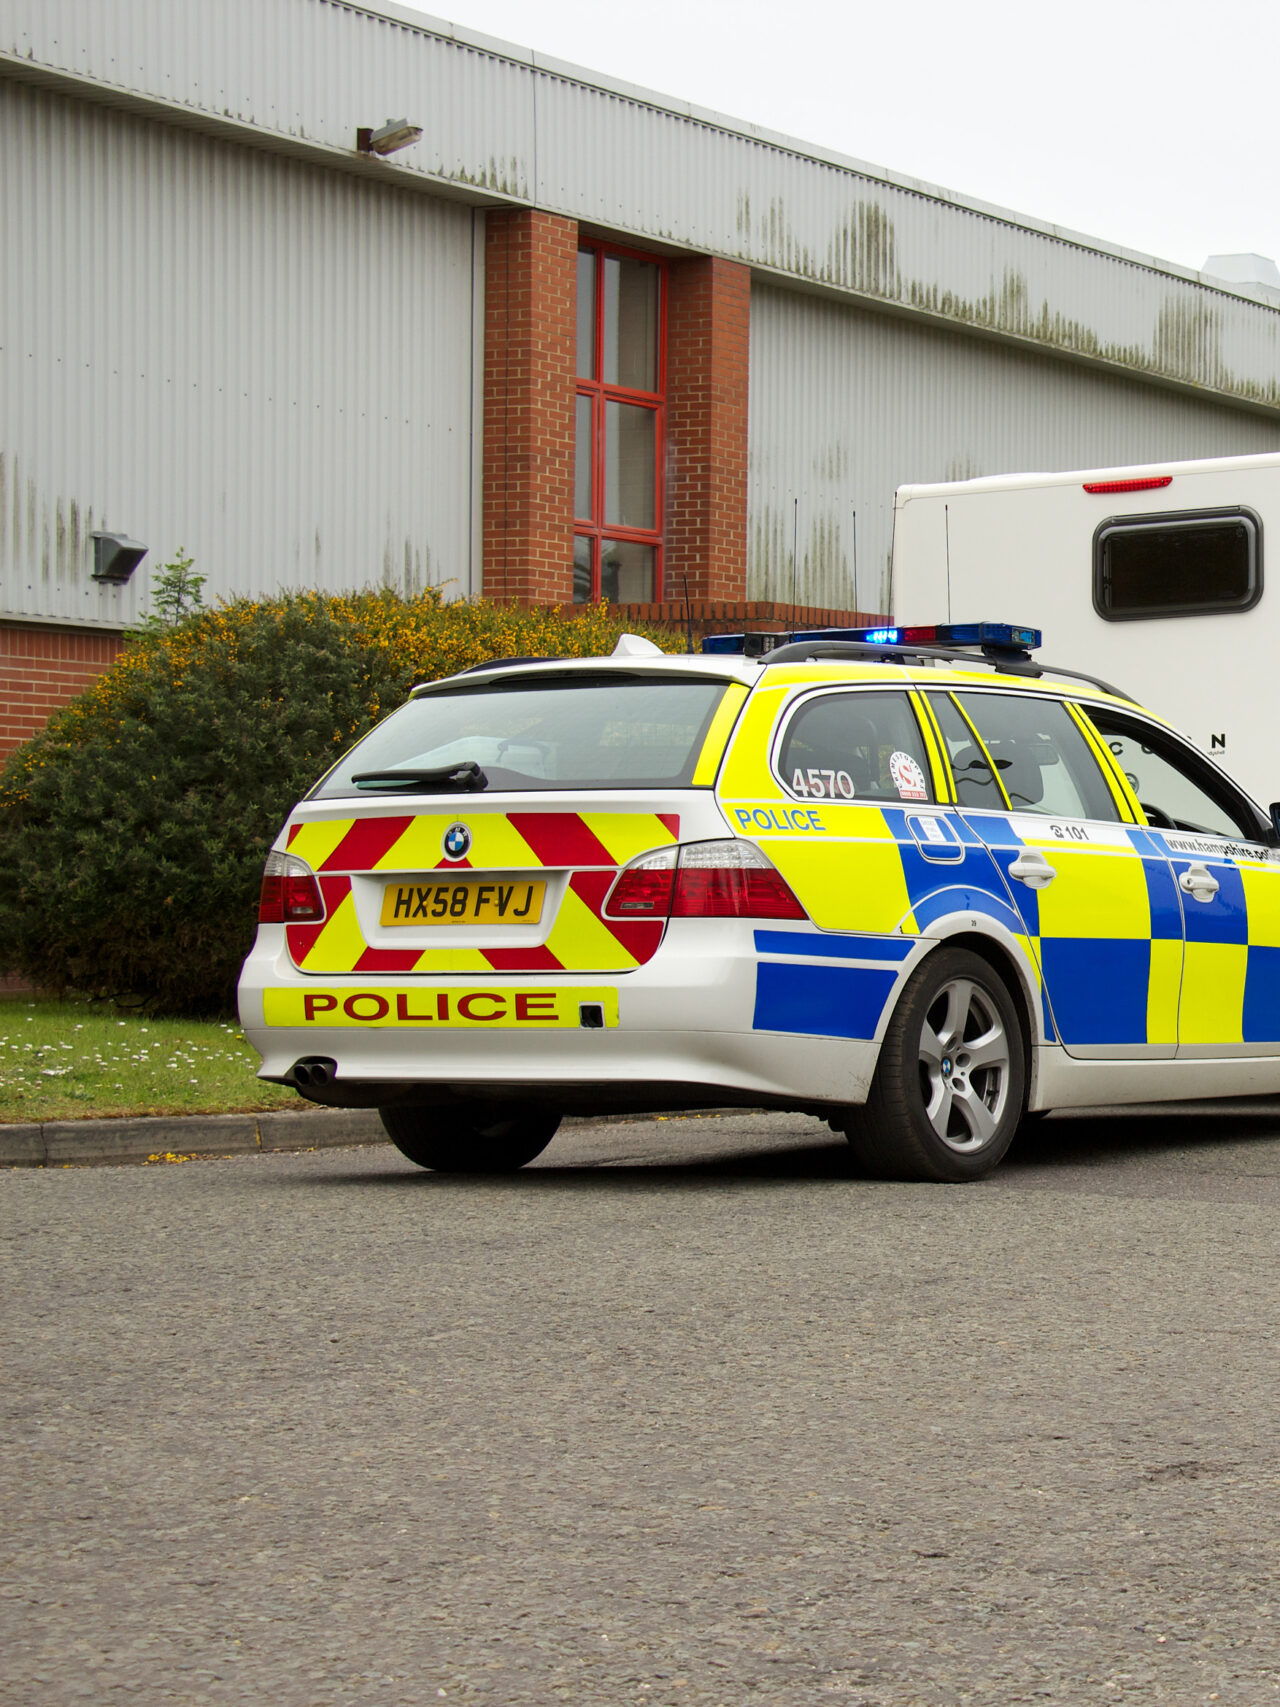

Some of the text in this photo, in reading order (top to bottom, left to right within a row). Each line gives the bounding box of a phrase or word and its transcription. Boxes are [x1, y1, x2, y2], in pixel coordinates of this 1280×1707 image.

[792, 768, 855, 799] 4570
[734, 808, 826, 831] POLICE
[1065, 825, 1090, 841] 101
[394, 886, 534, 918] HX58 FVJ
[303, 992, 560, 1021] POLICE
